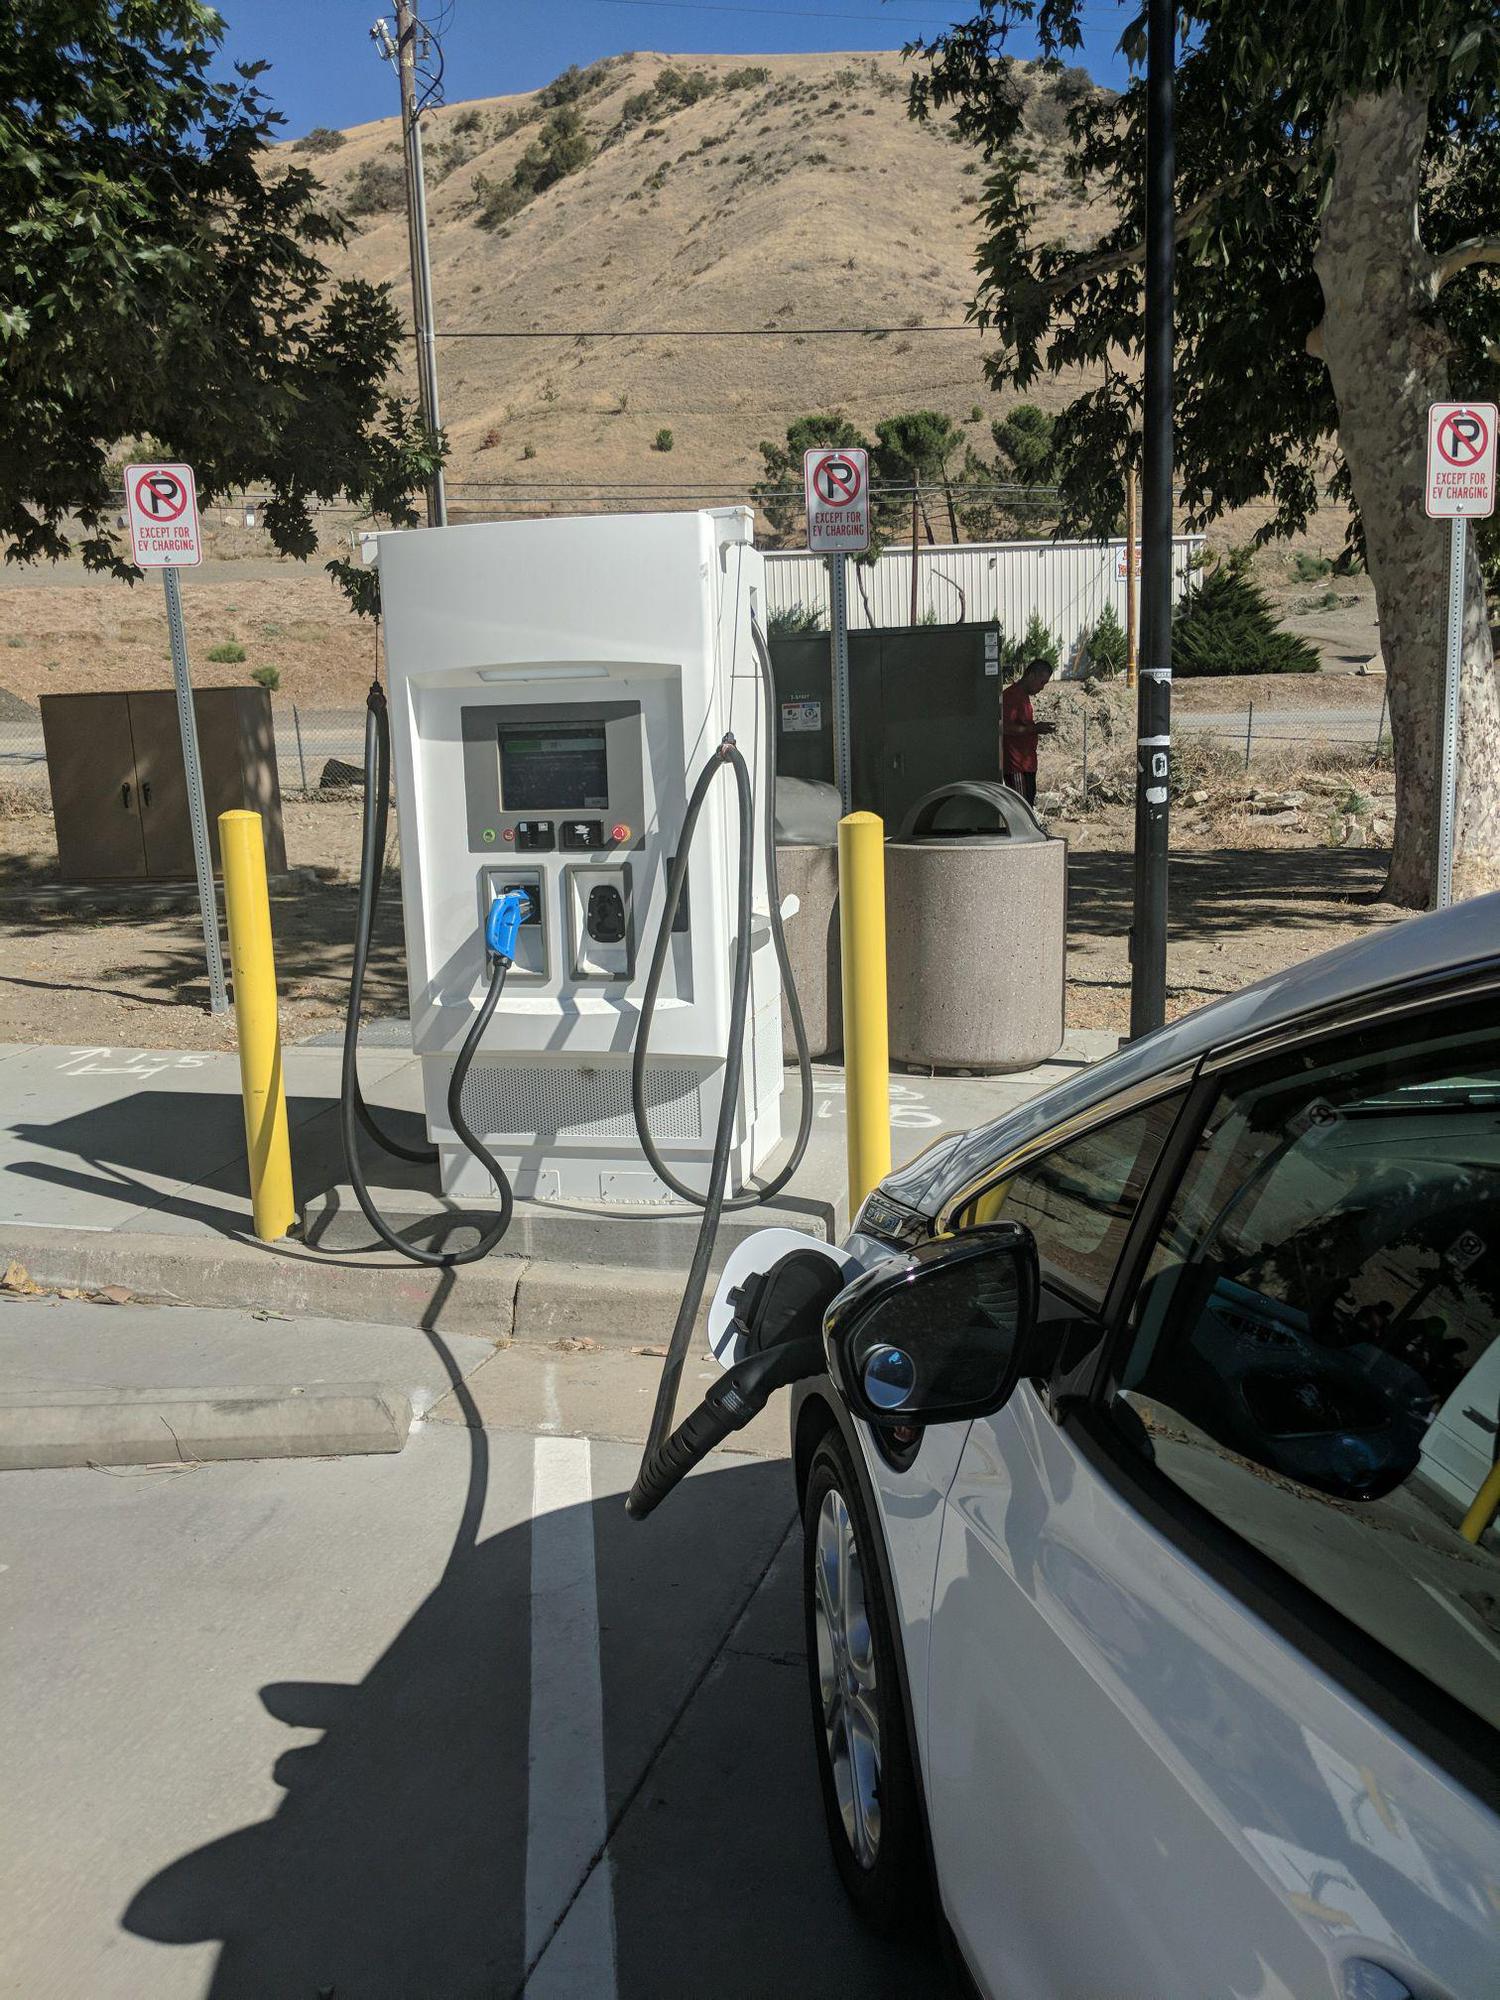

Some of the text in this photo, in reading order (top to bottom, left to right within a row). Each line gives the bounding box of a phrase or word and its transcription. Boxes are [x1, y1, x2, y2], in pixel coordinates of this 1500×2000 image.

[1436, 473, 1486, 485] EXCEPT FOR
[1433, 487, 1488, 499] EV CHARGING
[816, 511, 861, 524] EXCEPT FOR
[140, 526, 190, 538] EXCEPT FOR
[813, 525, 864, 536] EV CHARGING
[138, 539, 194, 551] EV CHARGING
